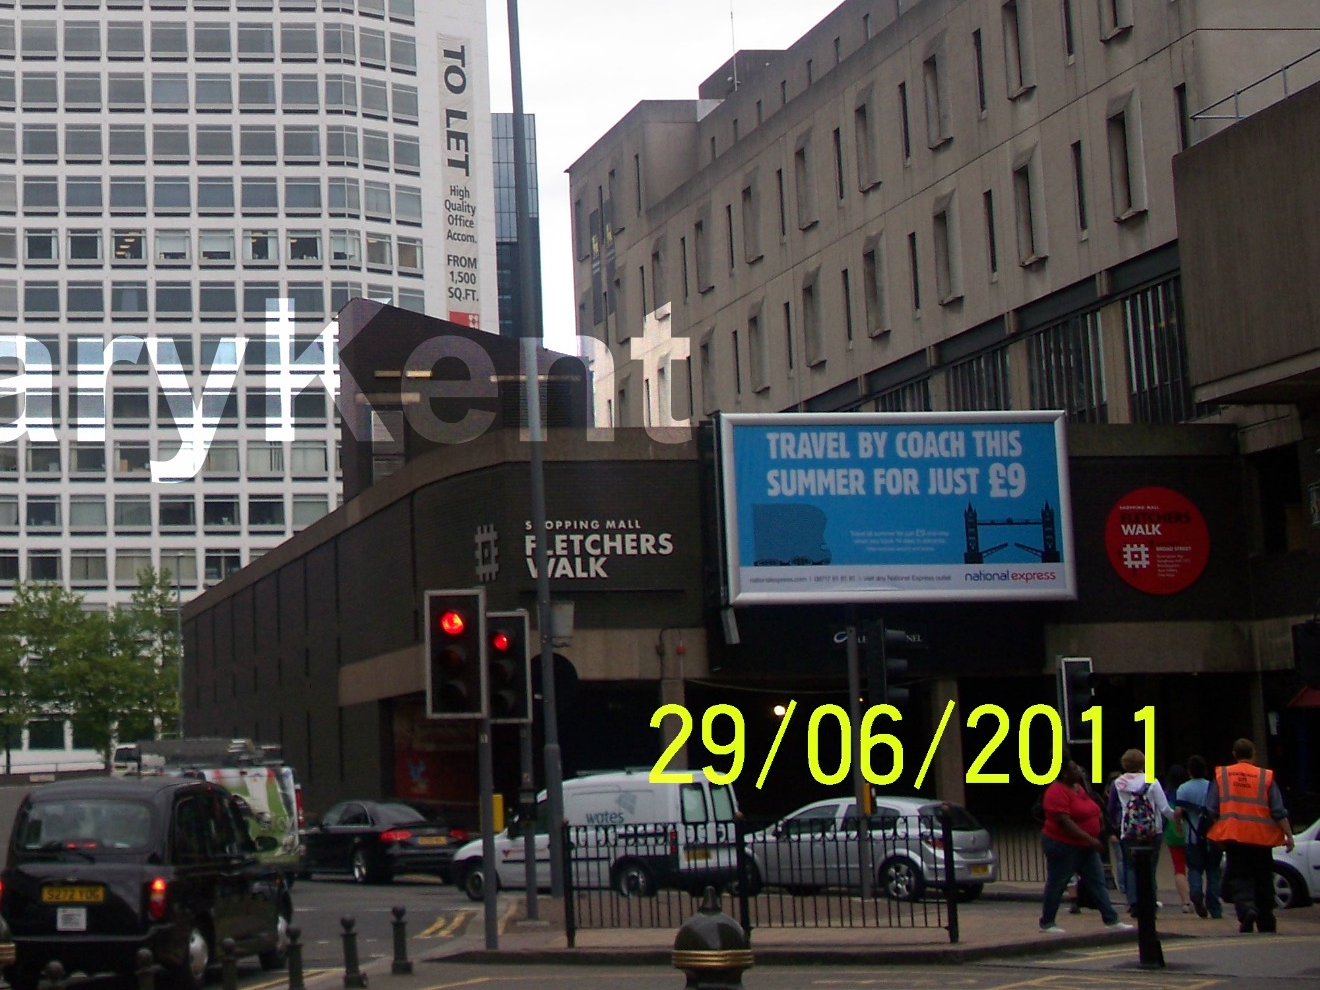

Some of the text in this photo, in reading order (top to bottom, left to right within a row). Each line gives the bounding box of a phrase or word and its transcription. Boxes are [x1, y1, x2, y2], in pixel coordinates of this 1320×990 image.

[443, 45, 470, 177] TO LET
[450, 185, 470, 200] High
[444, 199, 476, 216] Quality
[447, 214, 474, 229] Office
[446, 229, 477, 244] Accom.
[447, 254, 477, 270] FROM
[449, 270, 476, 285] 1,500
[448, 287, 479, 302] SQ.FT.
[767, 430, 1022, 458] TRAVEL BY COACH THIS
[767, 462, 1025, 498] SUMMER FOR JUST £9
[525, 519, 641, 530] SOPPING MALL
[1120, 512, 1192, 523] FLETCHERS
[1121, 524, 1162, 536] WALK
[911, 575, 935, 583] Express
[586, 811, 625, 824] wates
[47, 888, 75, 900] S272
